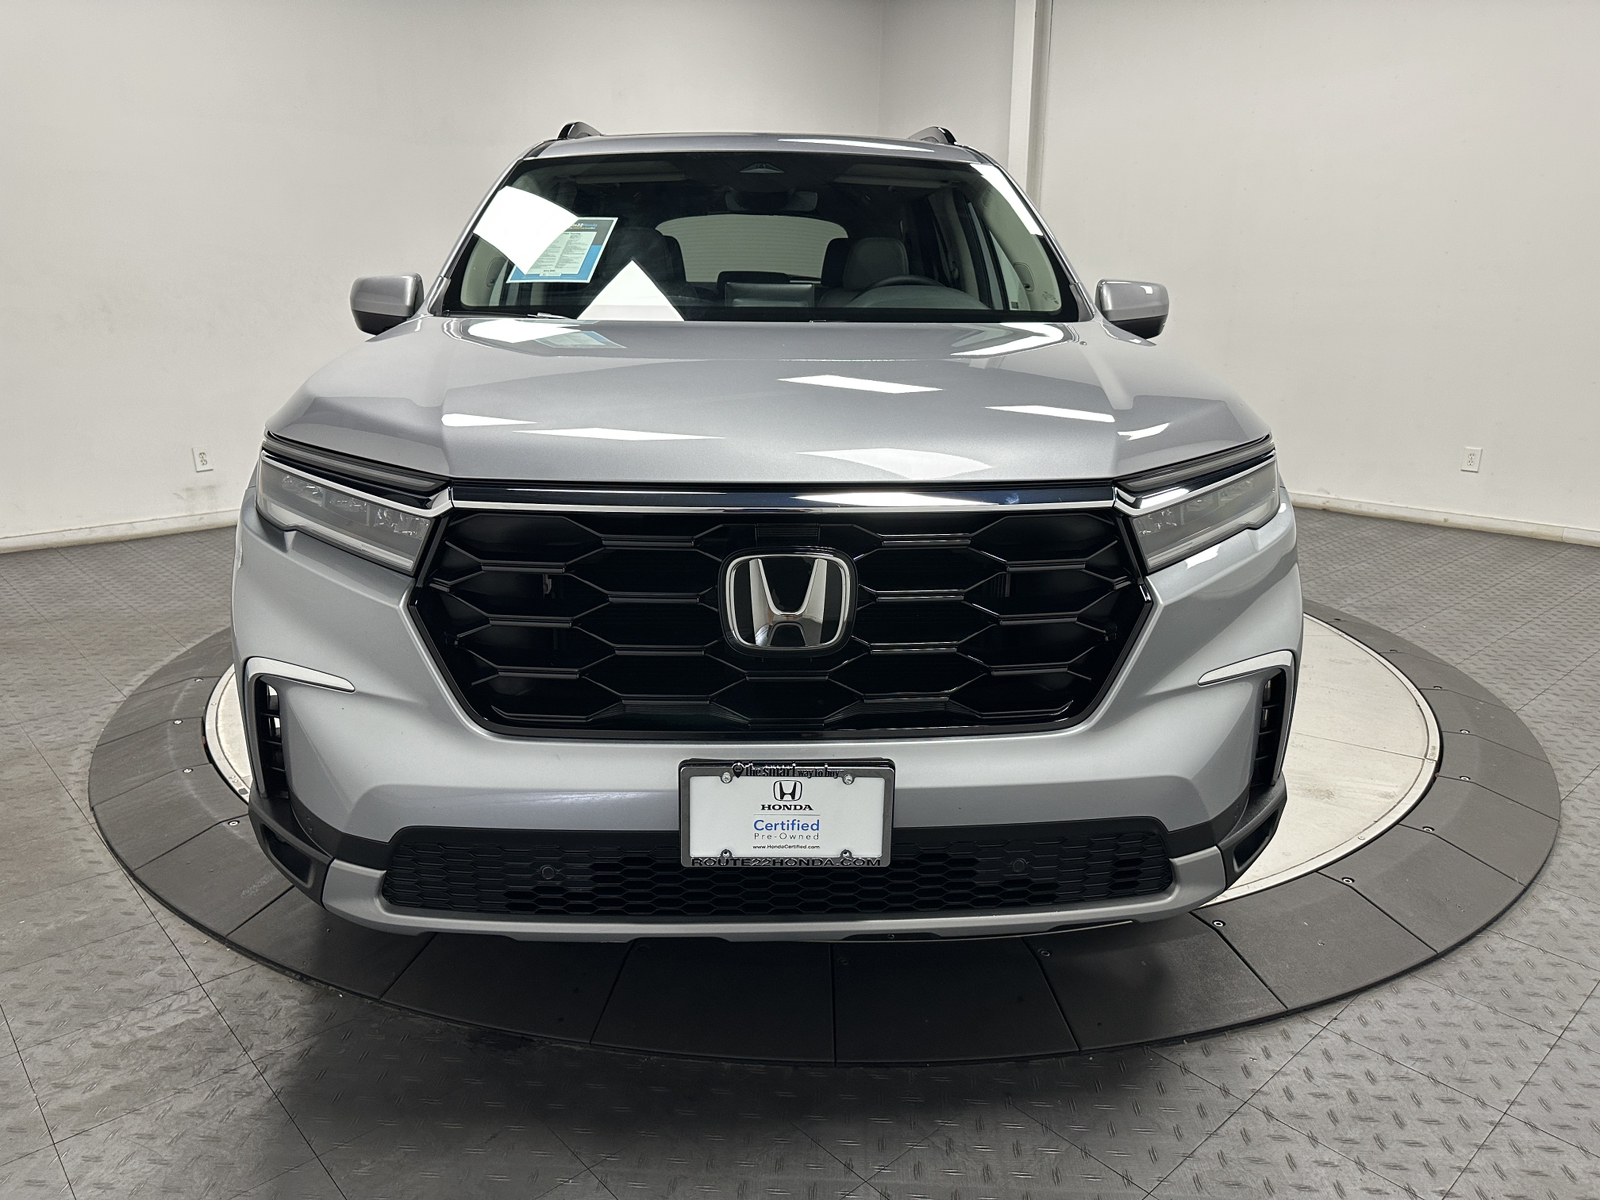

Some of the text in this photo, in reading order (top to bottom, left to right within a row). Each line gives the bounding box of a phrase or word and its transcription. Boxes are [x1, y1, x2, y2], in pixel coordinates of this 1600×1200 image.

[745, 762, 840, 779] the smart way to buy
[753, 819, 820, 831] Certified
[754, 832, 819, 841] Pre-Owned
[691, 858, 881, 867] ROUTE22HONDA.COM
